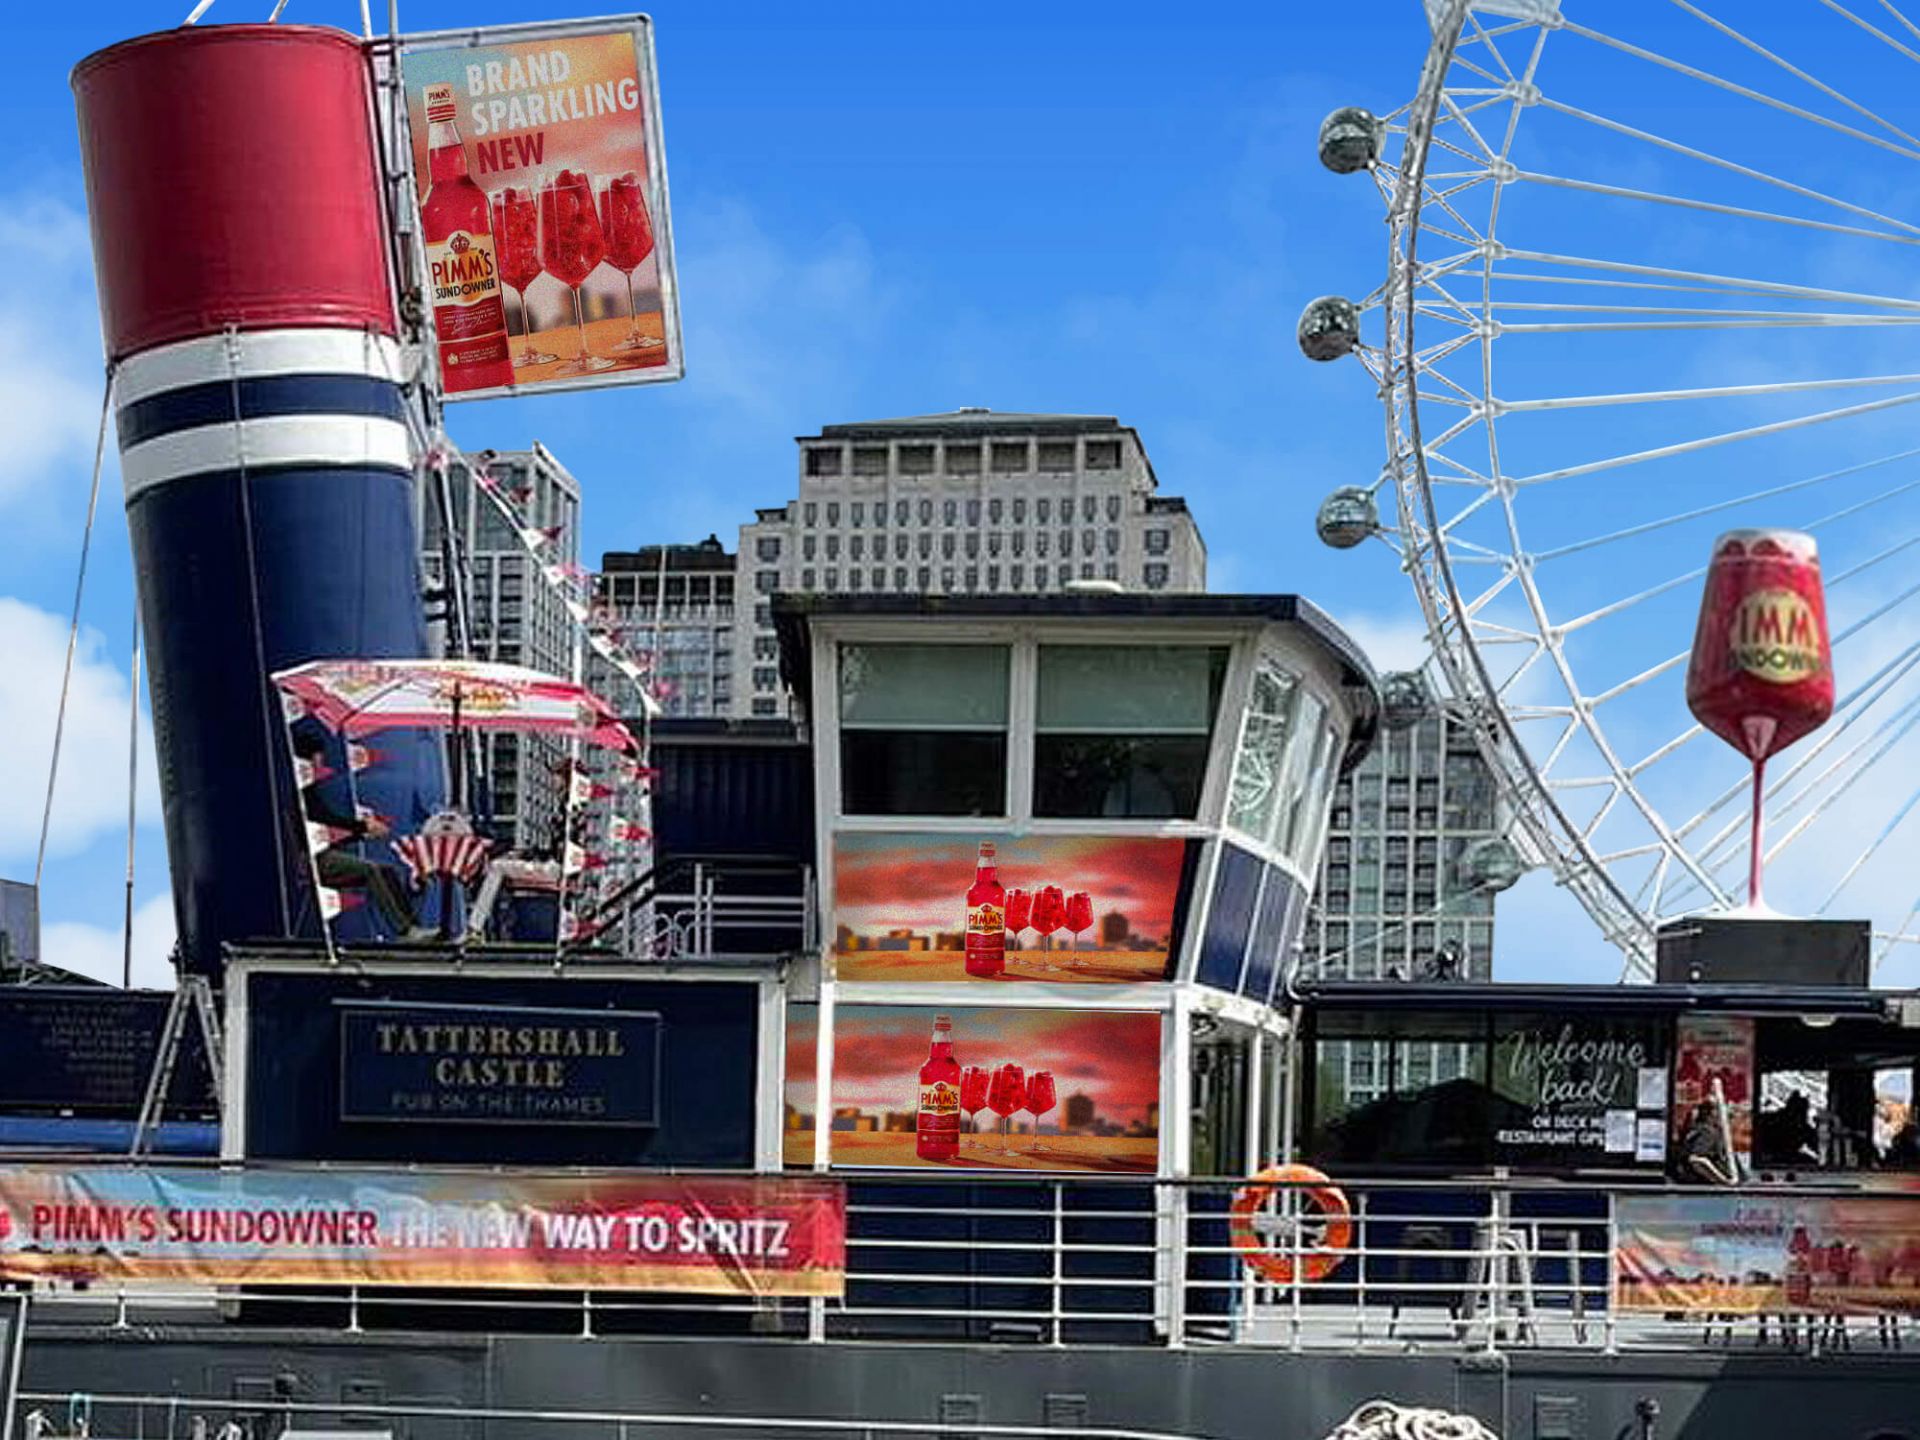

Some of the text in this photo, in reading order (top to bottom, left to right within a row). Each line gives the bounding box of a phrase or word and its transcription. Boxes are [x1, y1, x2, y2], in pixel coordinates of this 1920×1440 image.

[466, 50, 570, 97] BRAND
[471, 77, 639, 136] SPARKLING
[477, 132, 544, 174] NEW
[432, 248, 493, 285] PIMM'S
[435, 278, 496, 300] SUNDOWNER
[968, 912, 1003, 925] PIMM'S
[377, 1022, 625, 1056] TATTERSHALL
[1508, 1023, 1648, 1078] Welcome
[436, 1057, 566, 1088] CASTLE
[1541, 1066, 1622, 1105] back!
[921, 1091, 959, 1105] PIMM'S
[32, 1204, 790, 1257] PIMM'S SUNDOWNER THE NEW WAY TO SPRITZ
